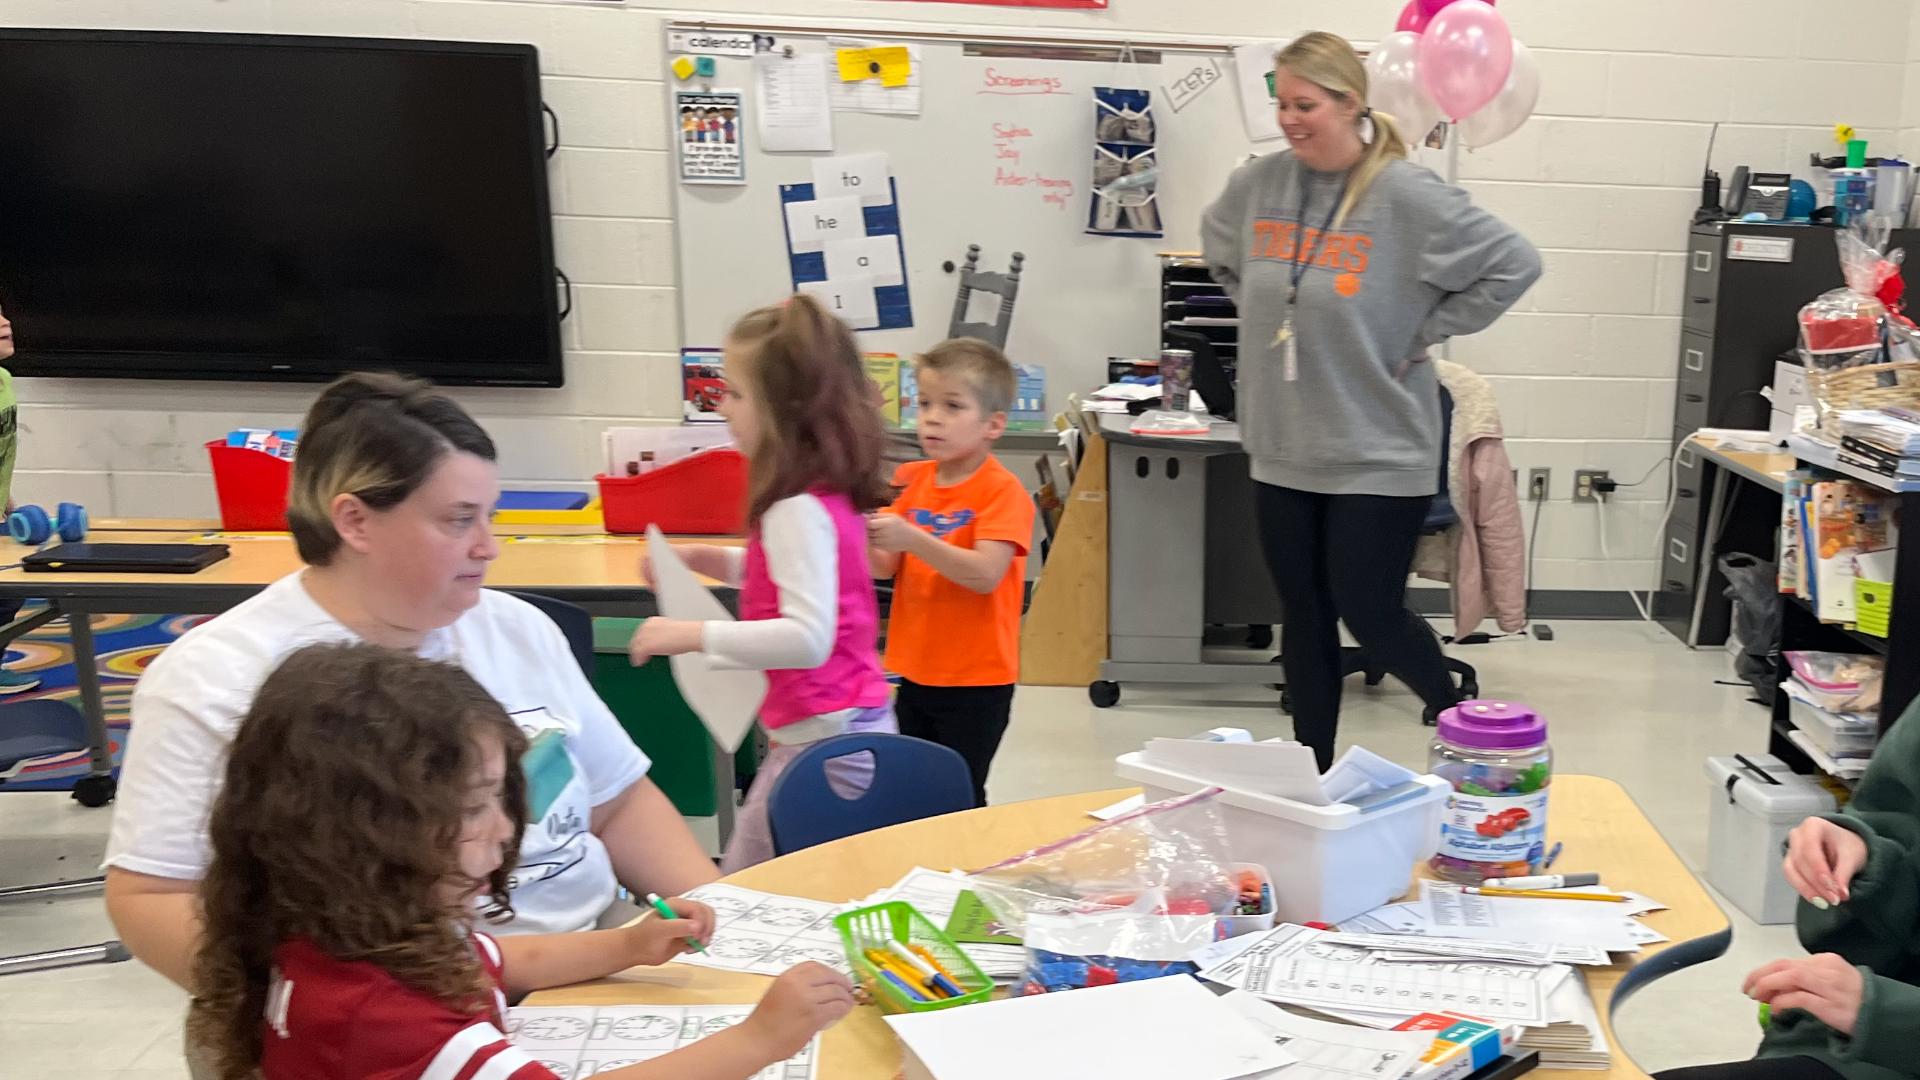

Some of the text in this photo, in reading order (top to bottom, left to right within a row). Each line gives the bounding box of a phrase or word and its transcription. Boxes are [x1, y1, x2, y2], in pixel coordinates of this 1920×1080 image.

[689, 36, 753, 49] calendar
[842, 172, 861, 187] to
[815, 214, 838, 230] he
[1252, 220, 1373, 273] TIGERS
[857, 256, 869, 267] a
